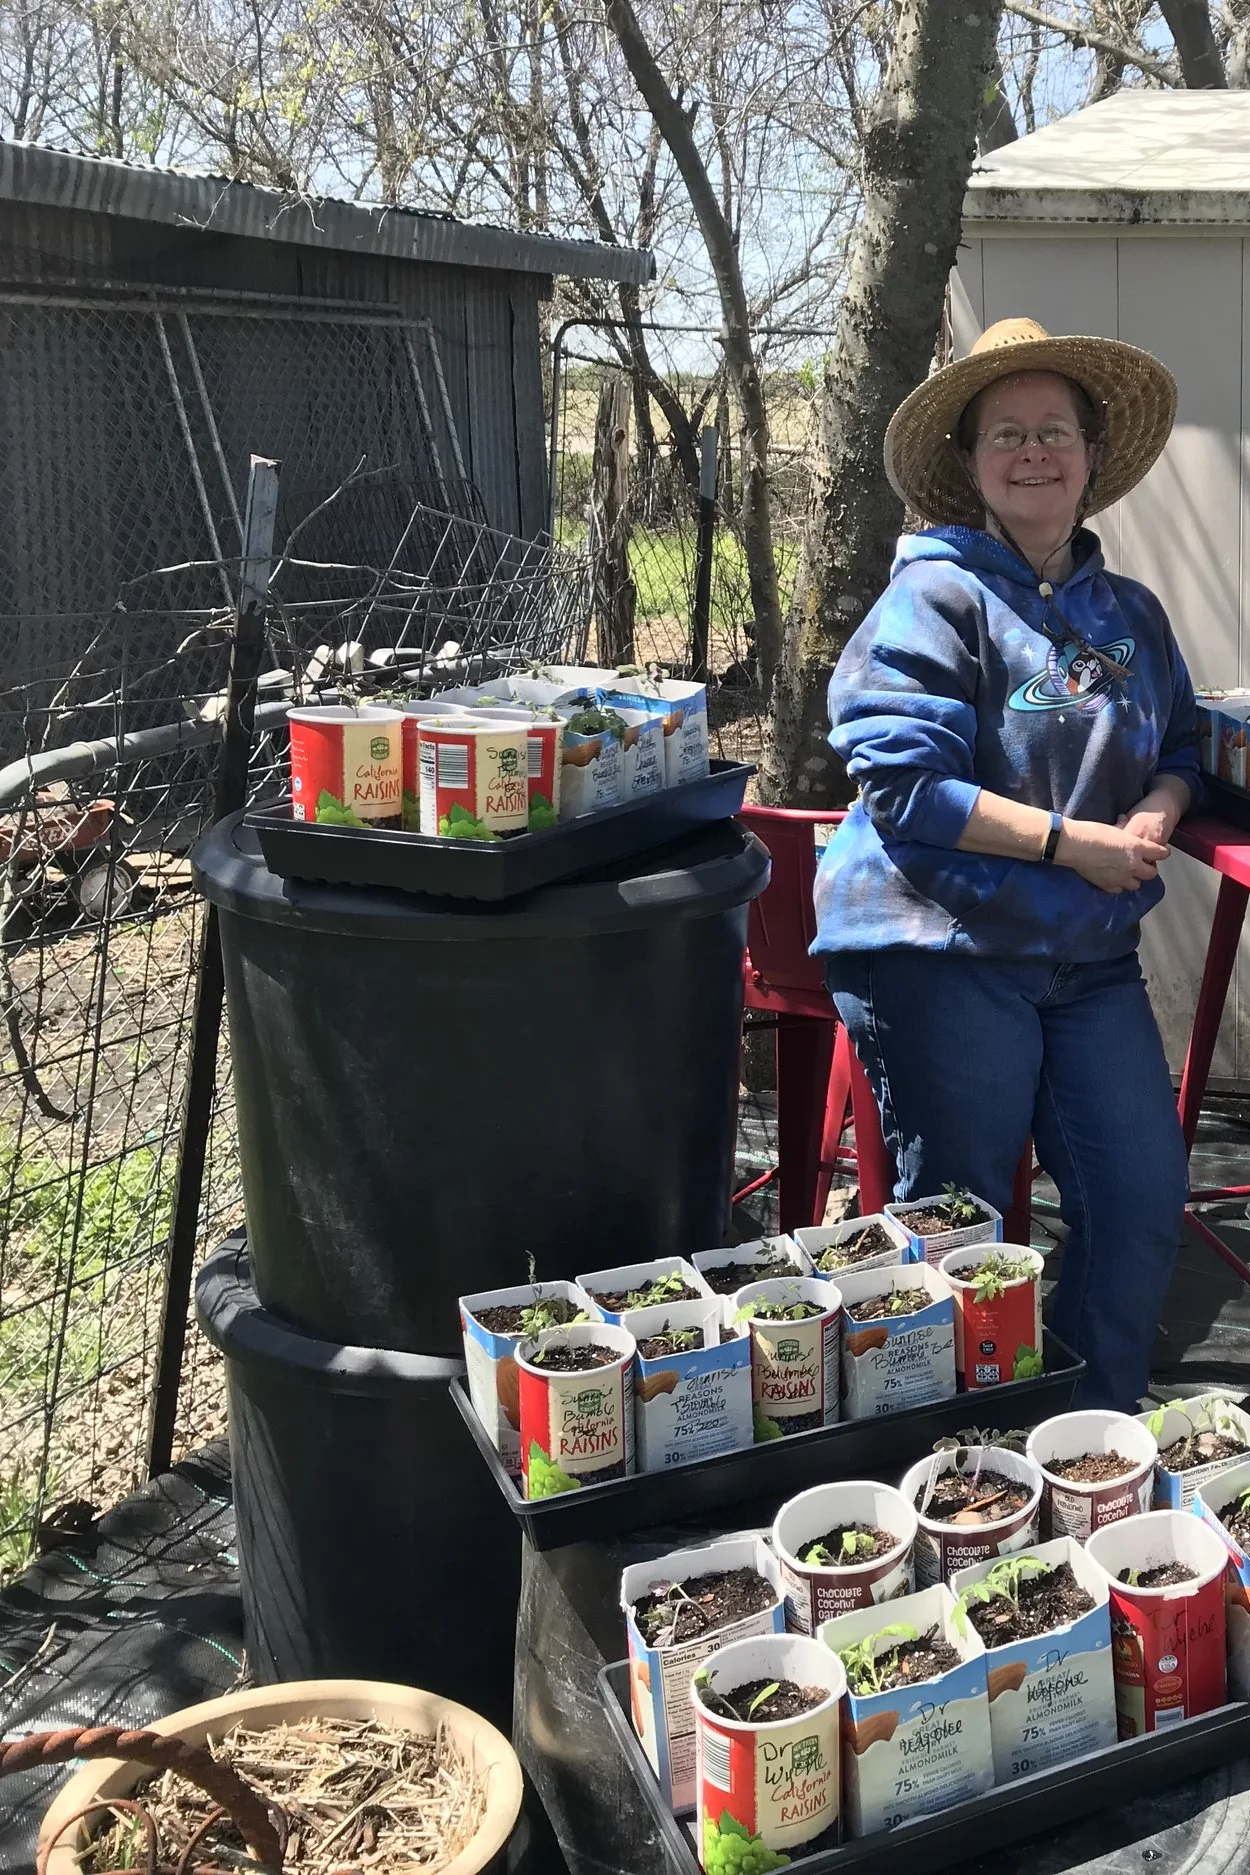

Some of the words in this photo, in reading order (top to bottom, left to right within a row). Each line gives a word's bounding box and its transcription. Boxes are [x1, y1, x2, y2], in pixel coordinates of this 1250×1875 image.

[354, 779, 400, 800] RAISINS
[888, 1342, 930, 1358] REASONS
[679, 1386, 723, 1402] REASONS
[884, 1378, 902, 1391] 75%
[560, 1426, 618, 1455] RAISINS
[664, 1452, 686, 1464] 30%
[663, 1653, 696, 1666] Calories
[707, 1643, 720, 1653] 30
[1041, 1649, 1069, 1672] Dr
[918, 1701, 951, 1725] Dr
[1026, 1696, 1083, 1723] ALMONDMILK
[1023, 1726, 1046, 1742] 75%
[758, 1741, 793, 1761] Dr
[898, 1746, 958, 1775] ALMONDMILK
[1012, 1759, 1037, 1775] 30%
[771, 1769, 831, 1802] California
[895, 1778, 919, 1796] 75%
[781, 1788, 826, 1821] RAISINS
